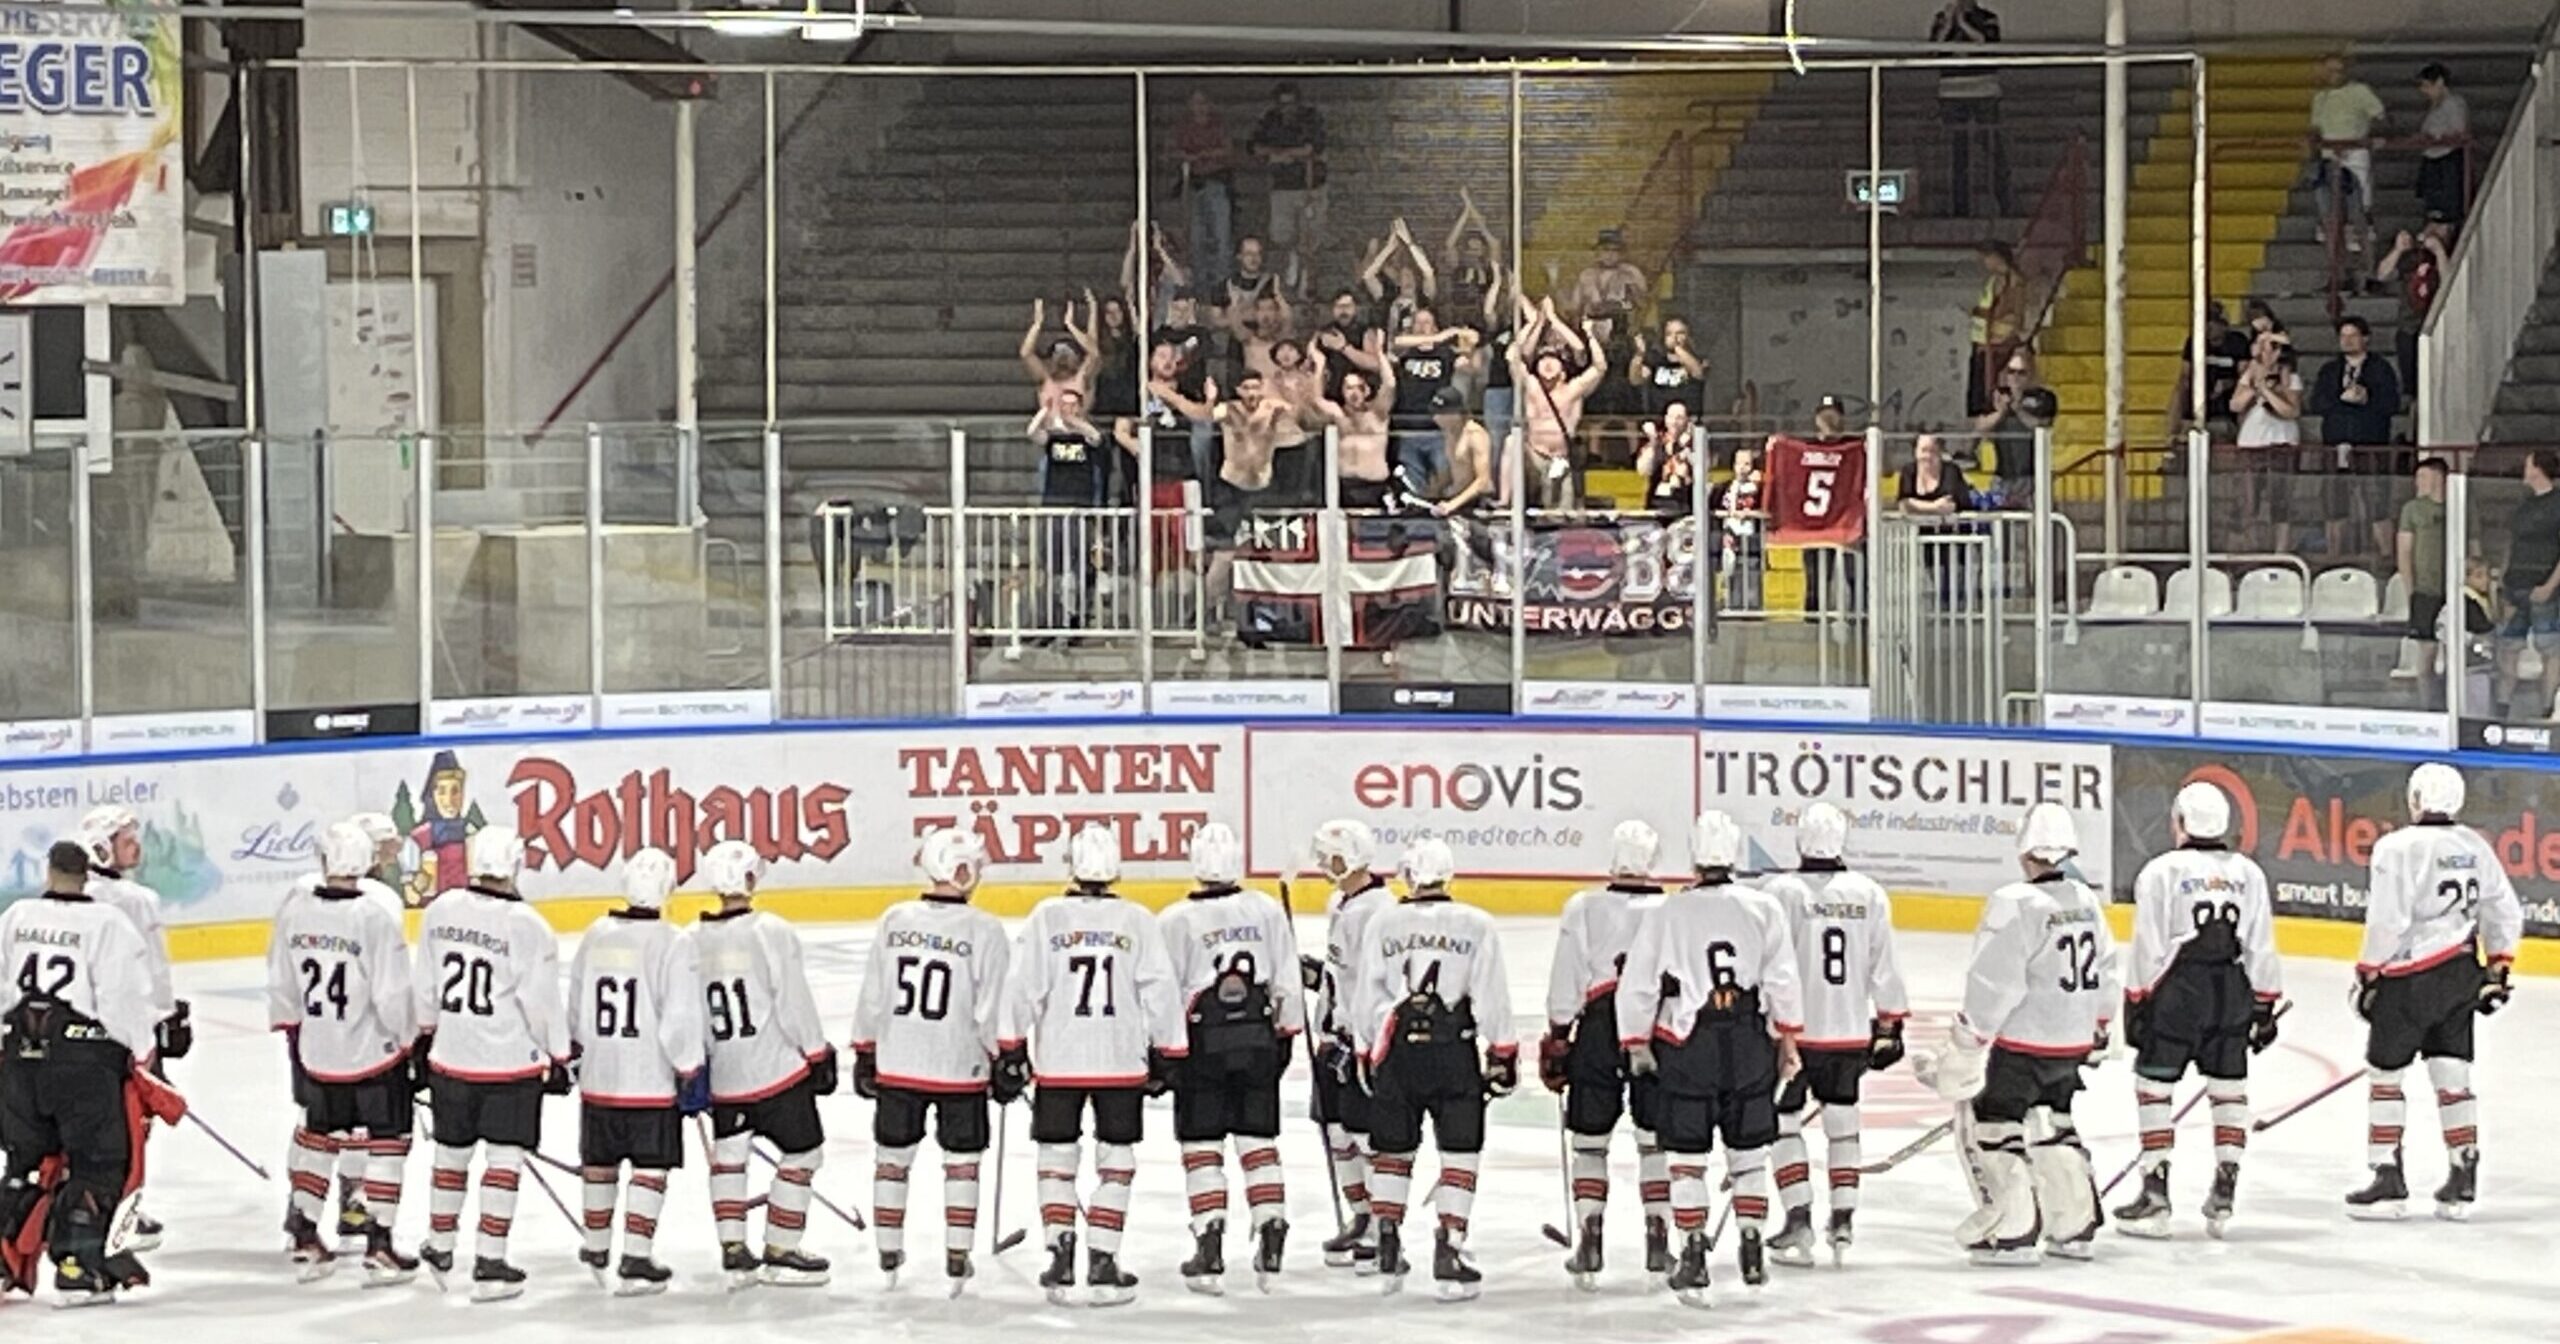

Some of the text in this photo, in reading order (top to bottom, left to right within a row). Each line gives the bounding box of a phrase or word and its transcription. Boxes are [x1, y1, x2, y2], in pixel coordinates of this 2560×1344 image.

[0, 44, 151, 107] EGER
[1803, 470, 1836, 517] 5
[86, 775, 159, 806] Lieler
[899, 744, 1221, 798] TANNEN
[1354, 754, 1583, 811] enovis
[1704, 741, 2103, 810] TRÖTSCHLER
[505, 757, 853, 886] Rothaus
[1371, 825, 1583, 848] novis-medtech.de
[2276, 881, 2339, 907] smart
[15, 928, 81, 949] HALLER
[1822, 926, 1847, 985] 8
[2055, 930, 2100, 993] 32
[301, 957, 348, 1021] 24
[441, 951, 494, 1017] 20
[595, 975, 640, 1038] 61
[706, 977, 757, 1042] 91
[893, 955, 953, 1021] 50
[1068, 954, 1117, 1018] 71
